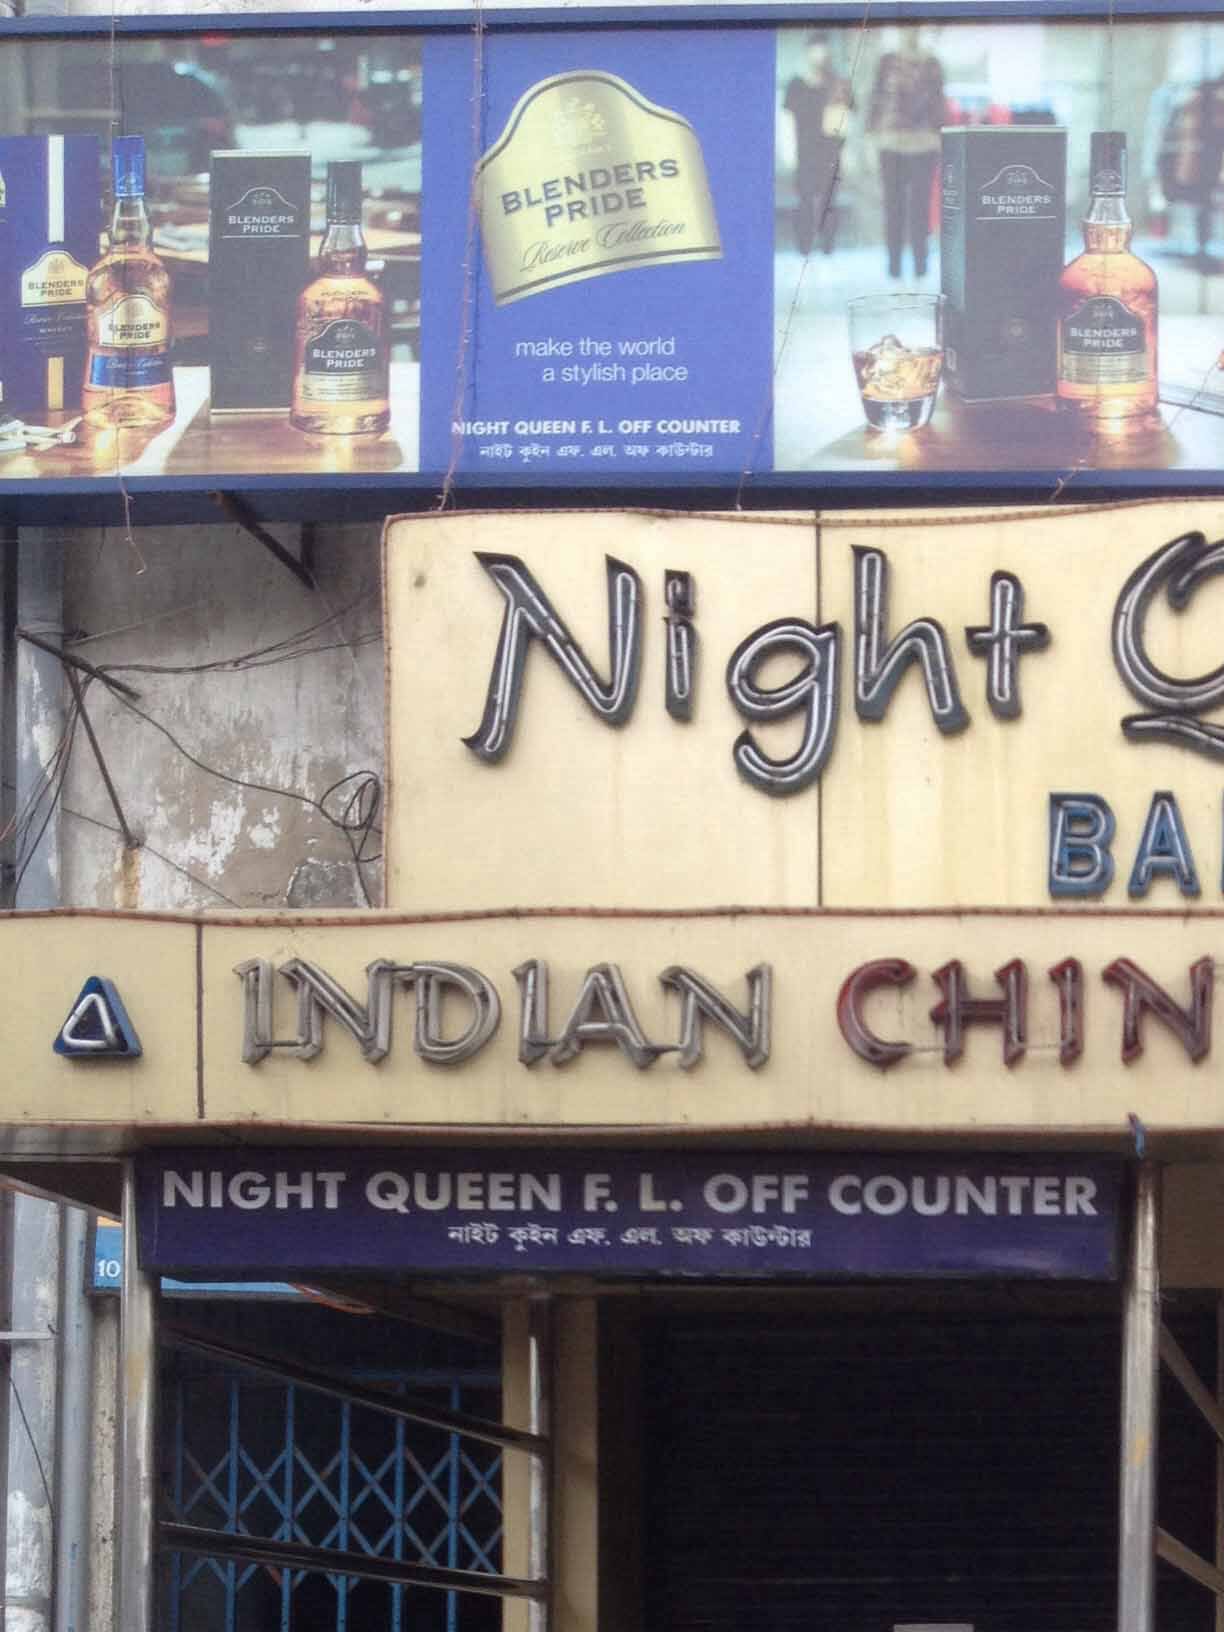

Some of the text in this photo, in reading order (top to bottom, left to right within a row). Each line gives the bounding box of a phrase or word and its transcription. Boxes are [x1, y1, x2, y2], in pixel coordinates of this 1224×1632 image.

[500, 159, 680, 216] BLENDERS
[228, 215, 294, 225] BLENDERS
[545, 187, 647, 228] PRIDE
[996, 205, 1037, 215] PRIDE
[242, 224, 280, 233] PRIDE
[519, 216, 686, 273] Reserve Collection
[515, 336, 675, 356] make the world
[326, 358, 365, 369] PRIDE
[543, 362, 688, 385] a stylish place
[451, 420, 742, 435] NIGHT QUEEN F. L. OFF COUNTER
[460, 543, 1053, 798] Night
[235, 955, 775, 1071] INDIAN
[163, 1171, 1099, 1216] NIGHT QUEEN F. L. OFF COUNTER
[447, 1222, 813, 1251] নাইট কুইন এফ. এল. অফ কাউন্টার
